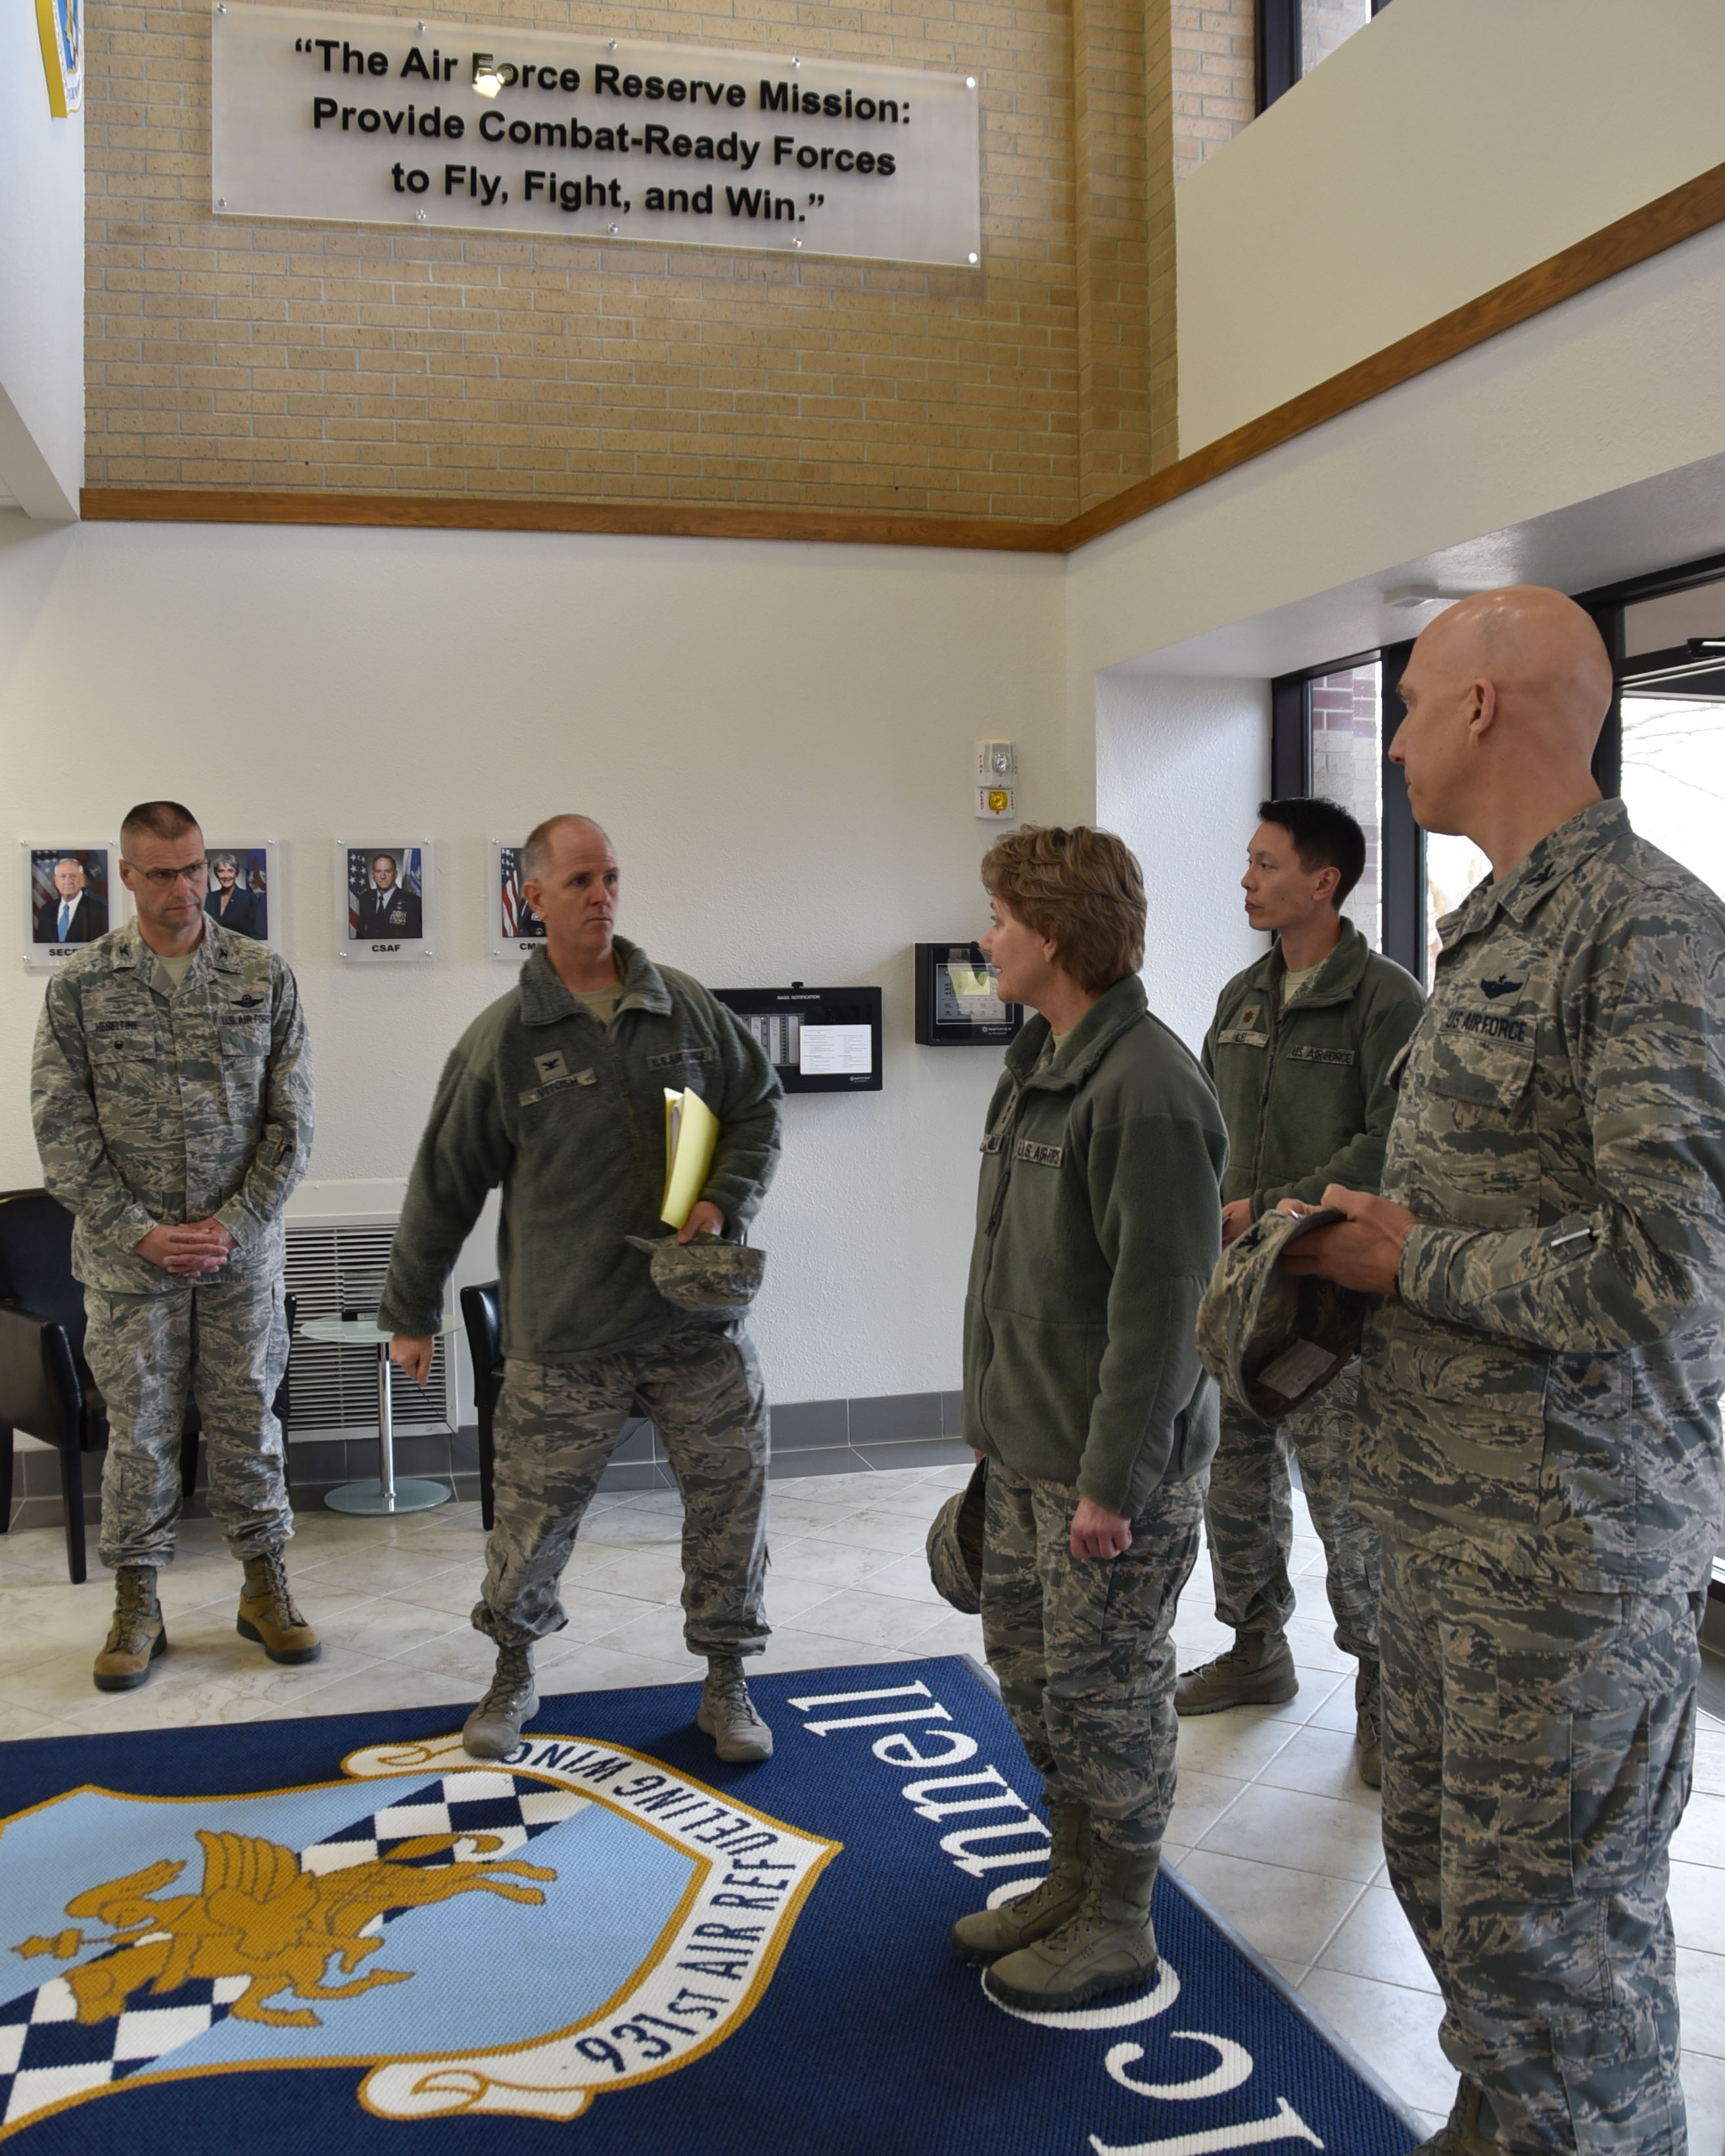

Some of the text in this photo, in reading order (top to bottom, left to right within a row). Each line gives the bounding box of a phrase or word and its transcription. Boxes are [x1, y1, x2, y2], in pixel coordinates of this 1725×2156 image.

[295, 37, 910, 124] “The Air Force Reserve Mission:
[314, 97, 896, 176] Provide Combat-Ready Forces
[391, 162, 825, 222] to Fly, Fight, and Win.”
[371, 944, 401, 952] CSAF
[238, 1015, 252, 1024] AIR
[1461, 1012, 1482, 1032] AIR
[1480, 1015, 1528, 1042] FORCE
[499, 1742, 633, 1783] WING
[676, 1922, 766, 1981] AIR
[575, 1987, 730, 2073] 931ST
